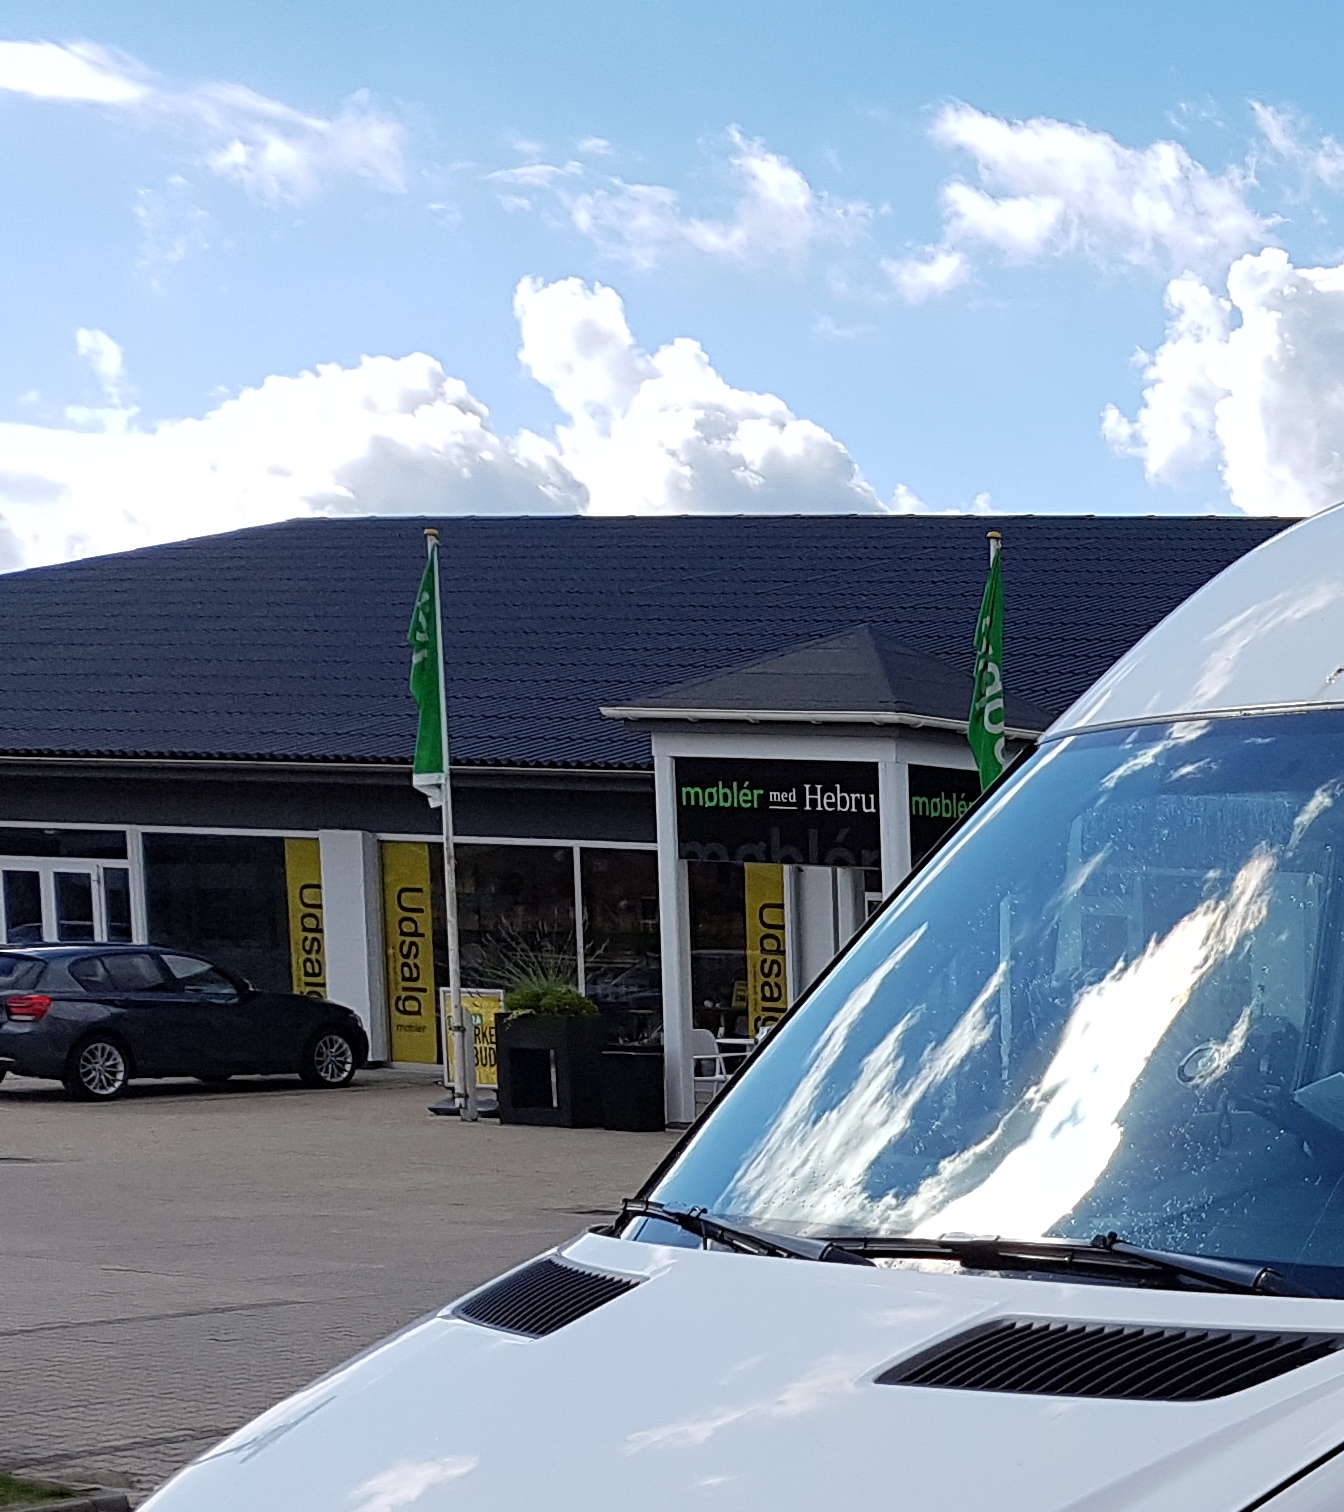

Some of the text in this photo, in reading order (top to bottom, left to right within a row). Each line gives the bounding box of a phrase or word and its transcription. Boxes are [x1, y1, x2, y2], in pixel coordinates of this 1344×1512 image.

[682, 780, 877, 813] møblér med Hebru
[395, 888, 427, 1016] Udsalg
